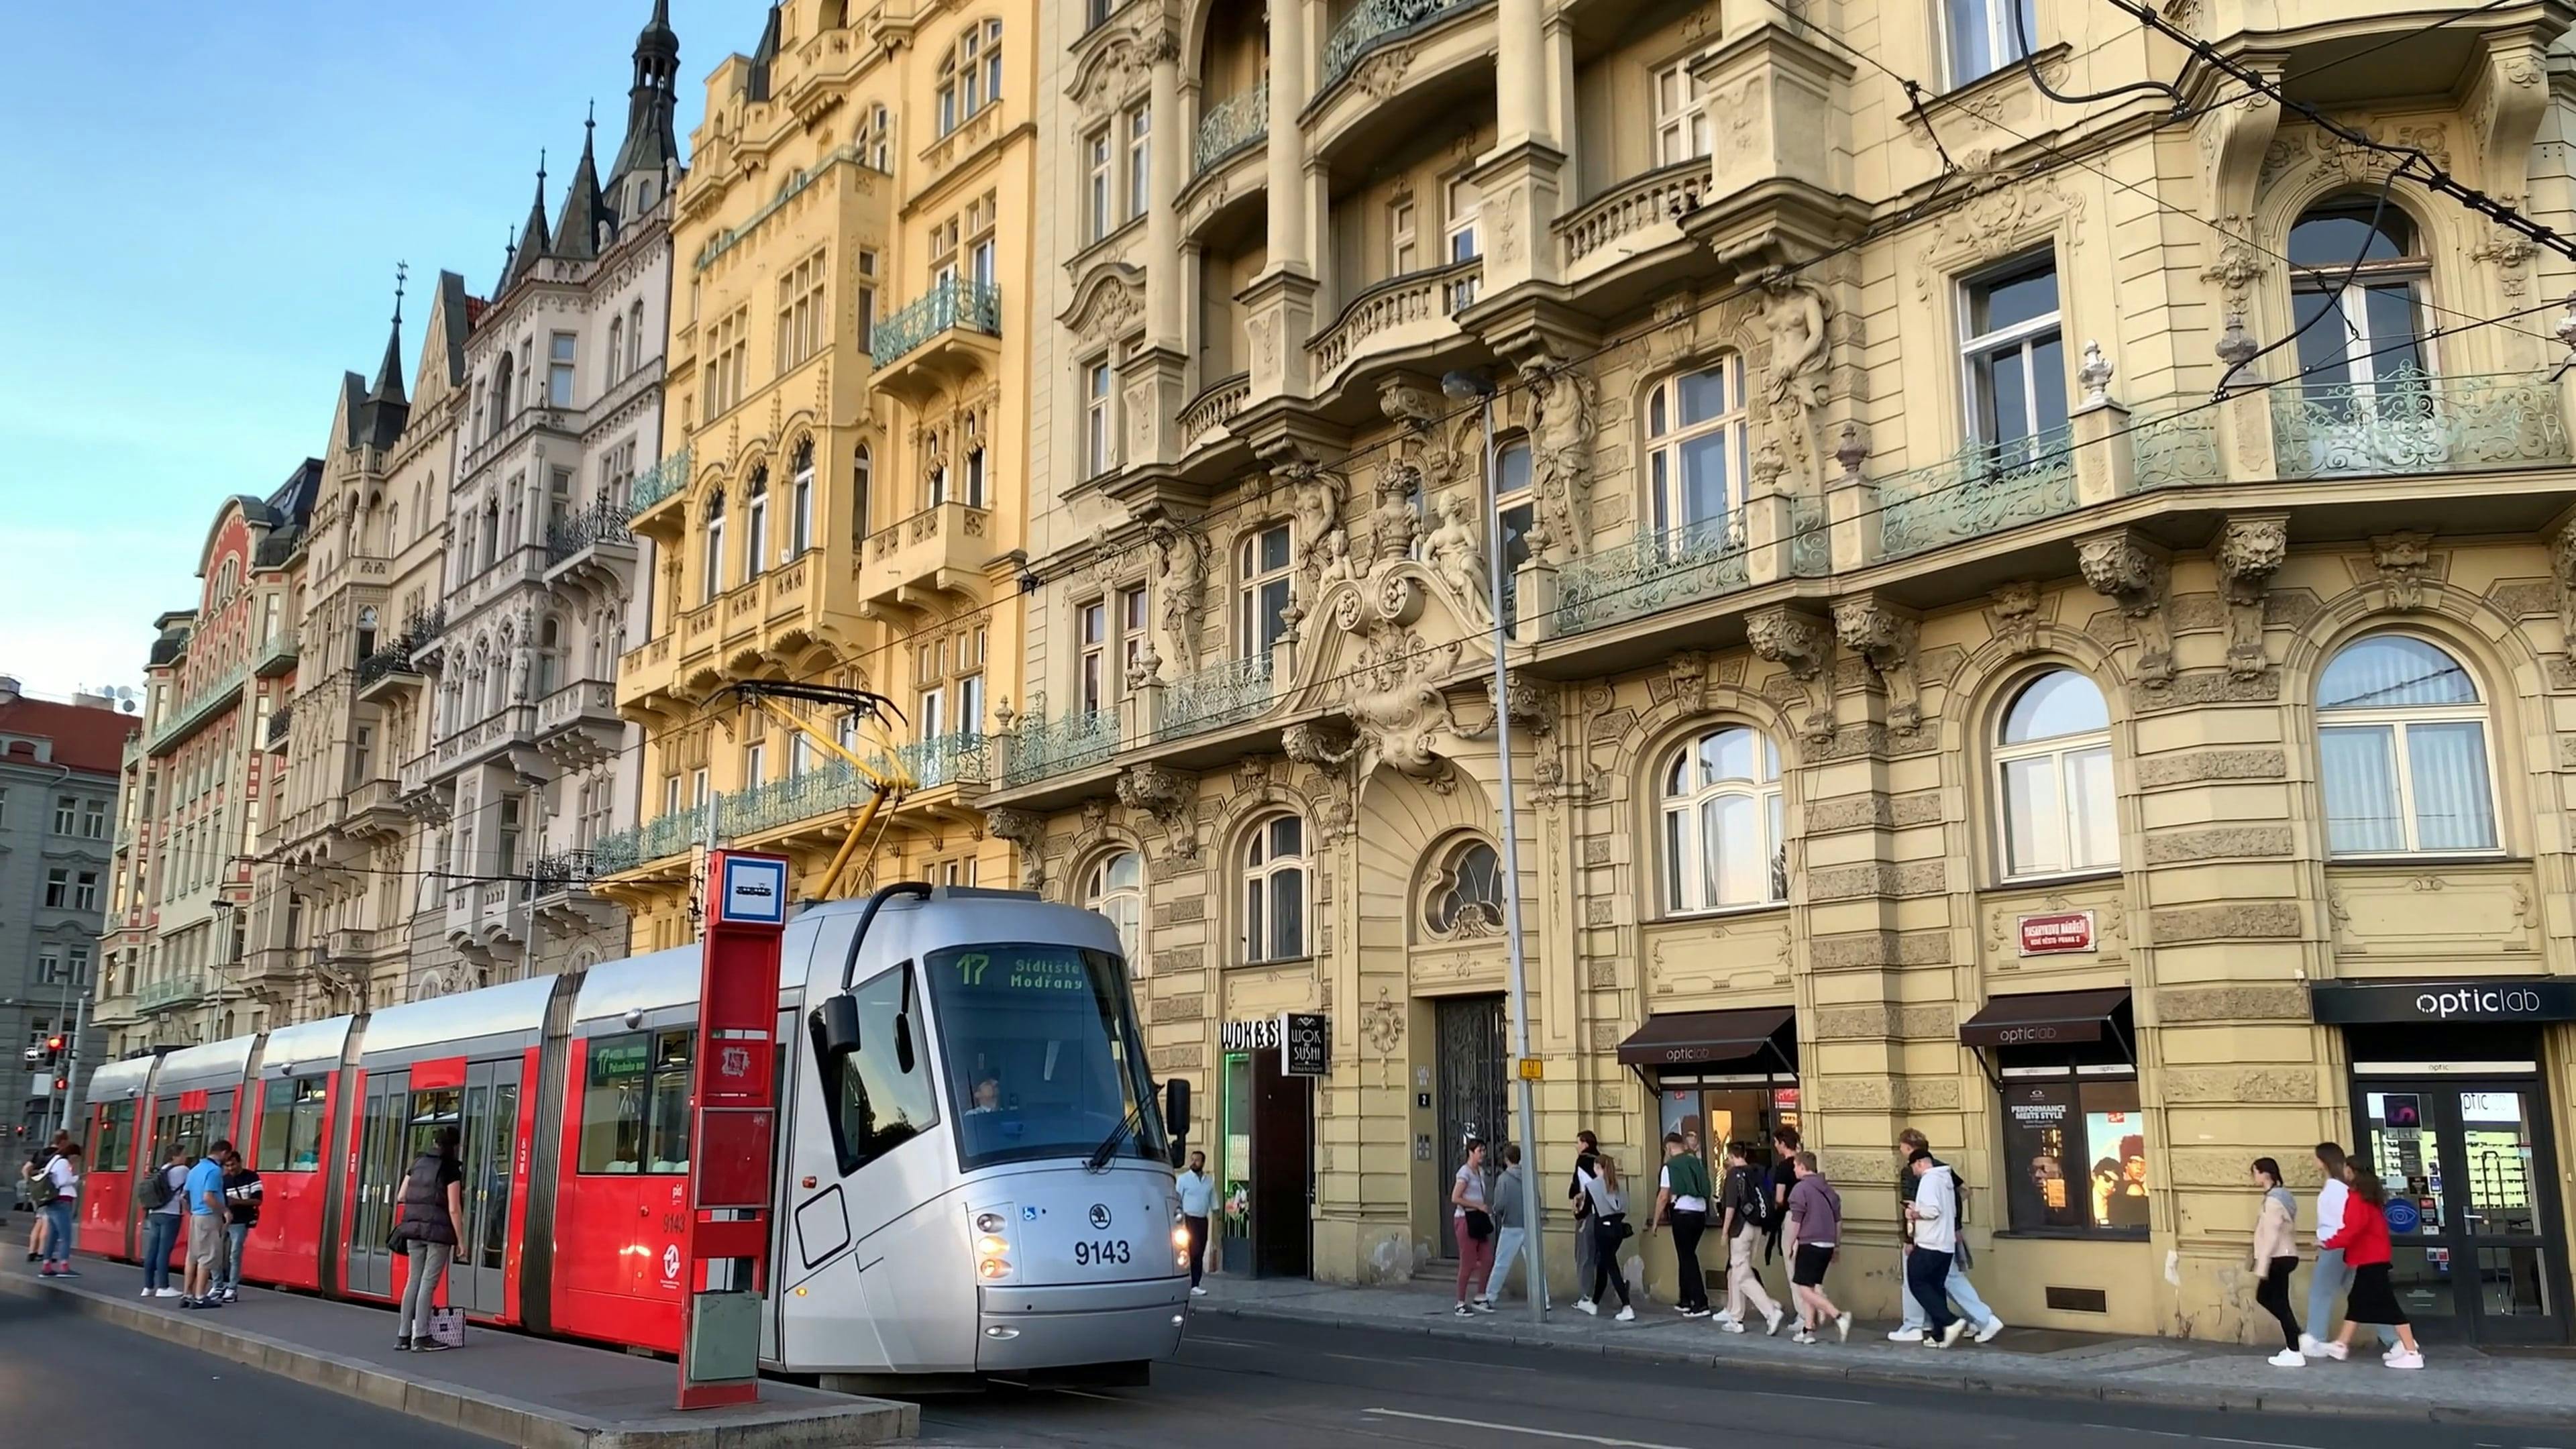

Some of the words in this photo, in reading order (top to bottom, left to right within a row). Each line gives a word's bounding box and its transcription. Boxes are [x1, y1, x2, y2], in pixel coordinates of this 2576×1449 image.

[956, 953, 990, 985] 17
[1010, 975, 1082, 989] Modřany
[2416, 988, 2540, 1018] opticlab
[1291, 1029, 1322, 1044] WOK
[2000, 1027, 2056, 1043] opticlab
[1294, 1046, 1320, 1061] SUSHI
[1666, 1047, 1709, 1062] opticlab
[2011, 1105, 2066, 1113] PERFORMANCE
[1075, 1240, 1130, 1266] 9143
